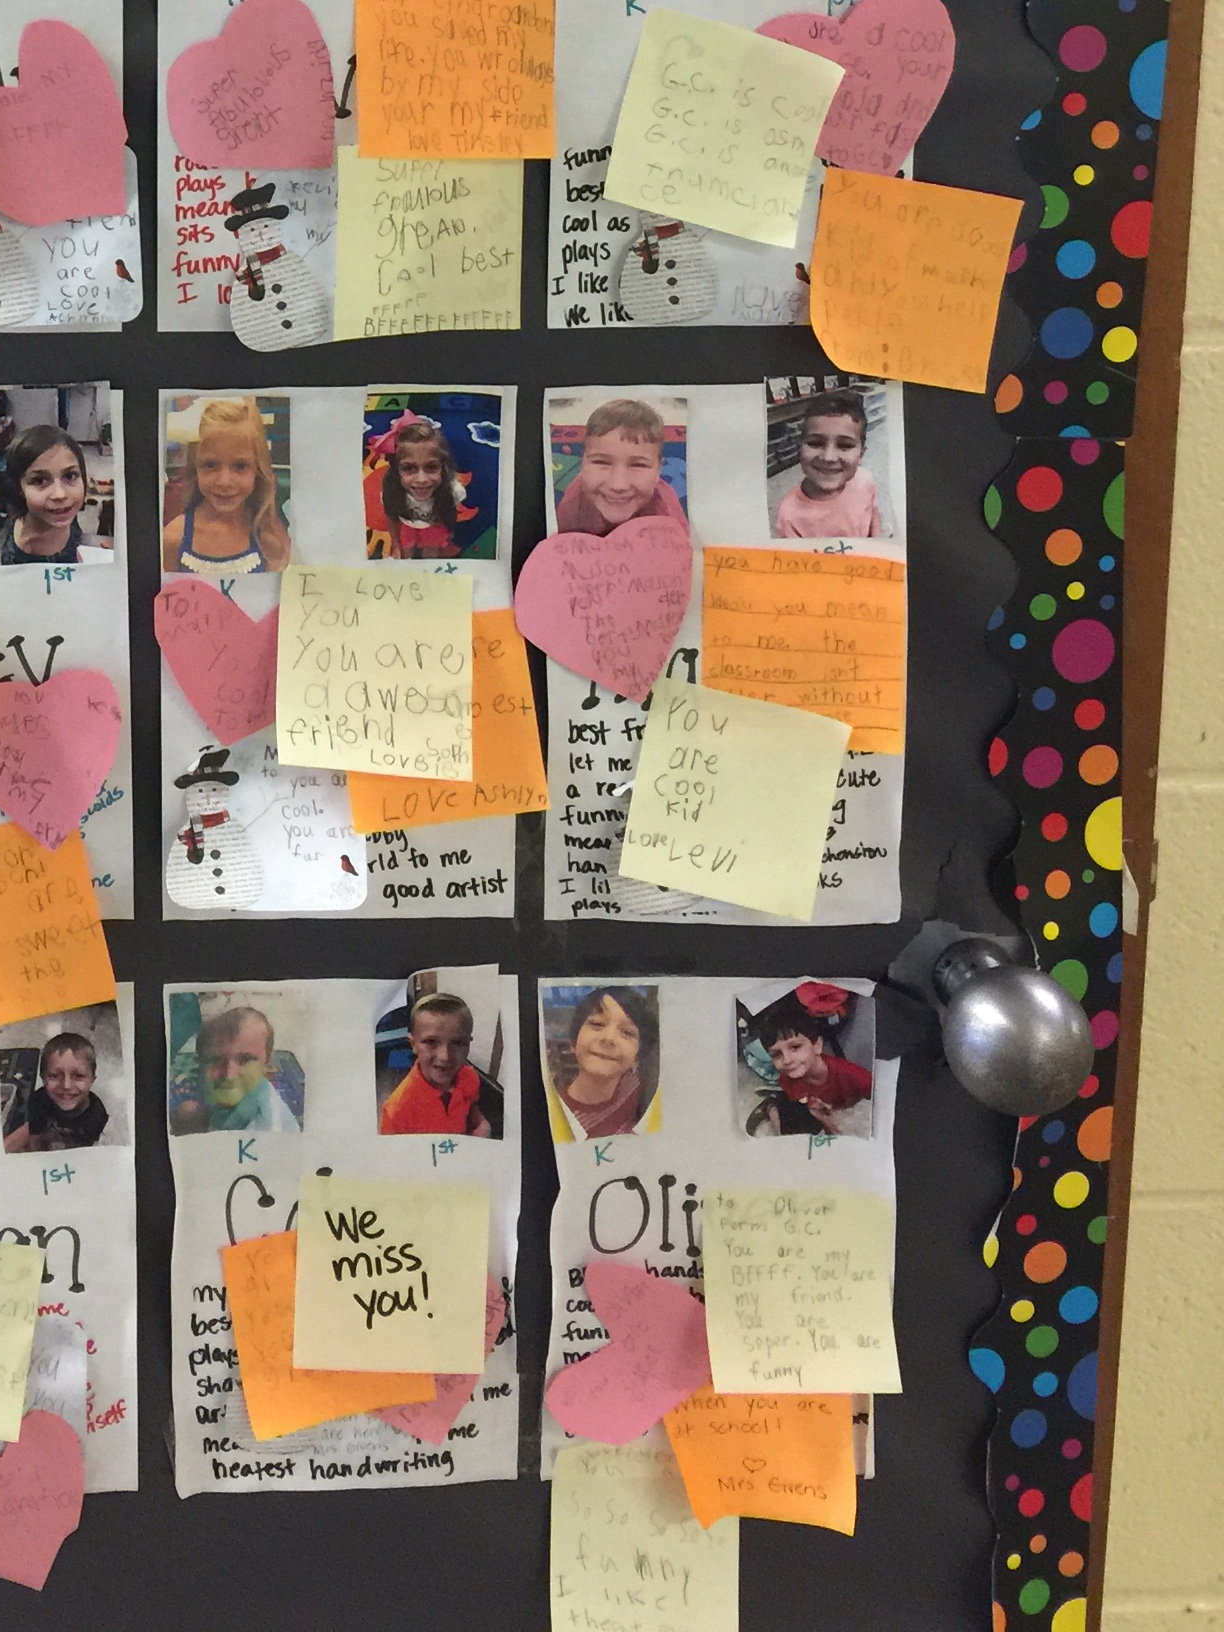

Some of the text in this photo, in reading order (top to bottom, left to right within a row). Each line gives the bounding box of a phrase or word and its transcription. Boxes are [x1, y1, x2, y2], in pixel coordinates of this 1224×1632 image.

[568, 720, 611, 745] best
[440, 850, 472, 867] me
[383, 869, 509, 909] good artist
[238, 1139, 258, 1163] K
[594, 1144, 614, 1165] K
[324, 1207, 385, 1243] We
[332, 1244, 422, 1280] miss
[353, 1272, 435, 1330] you!
